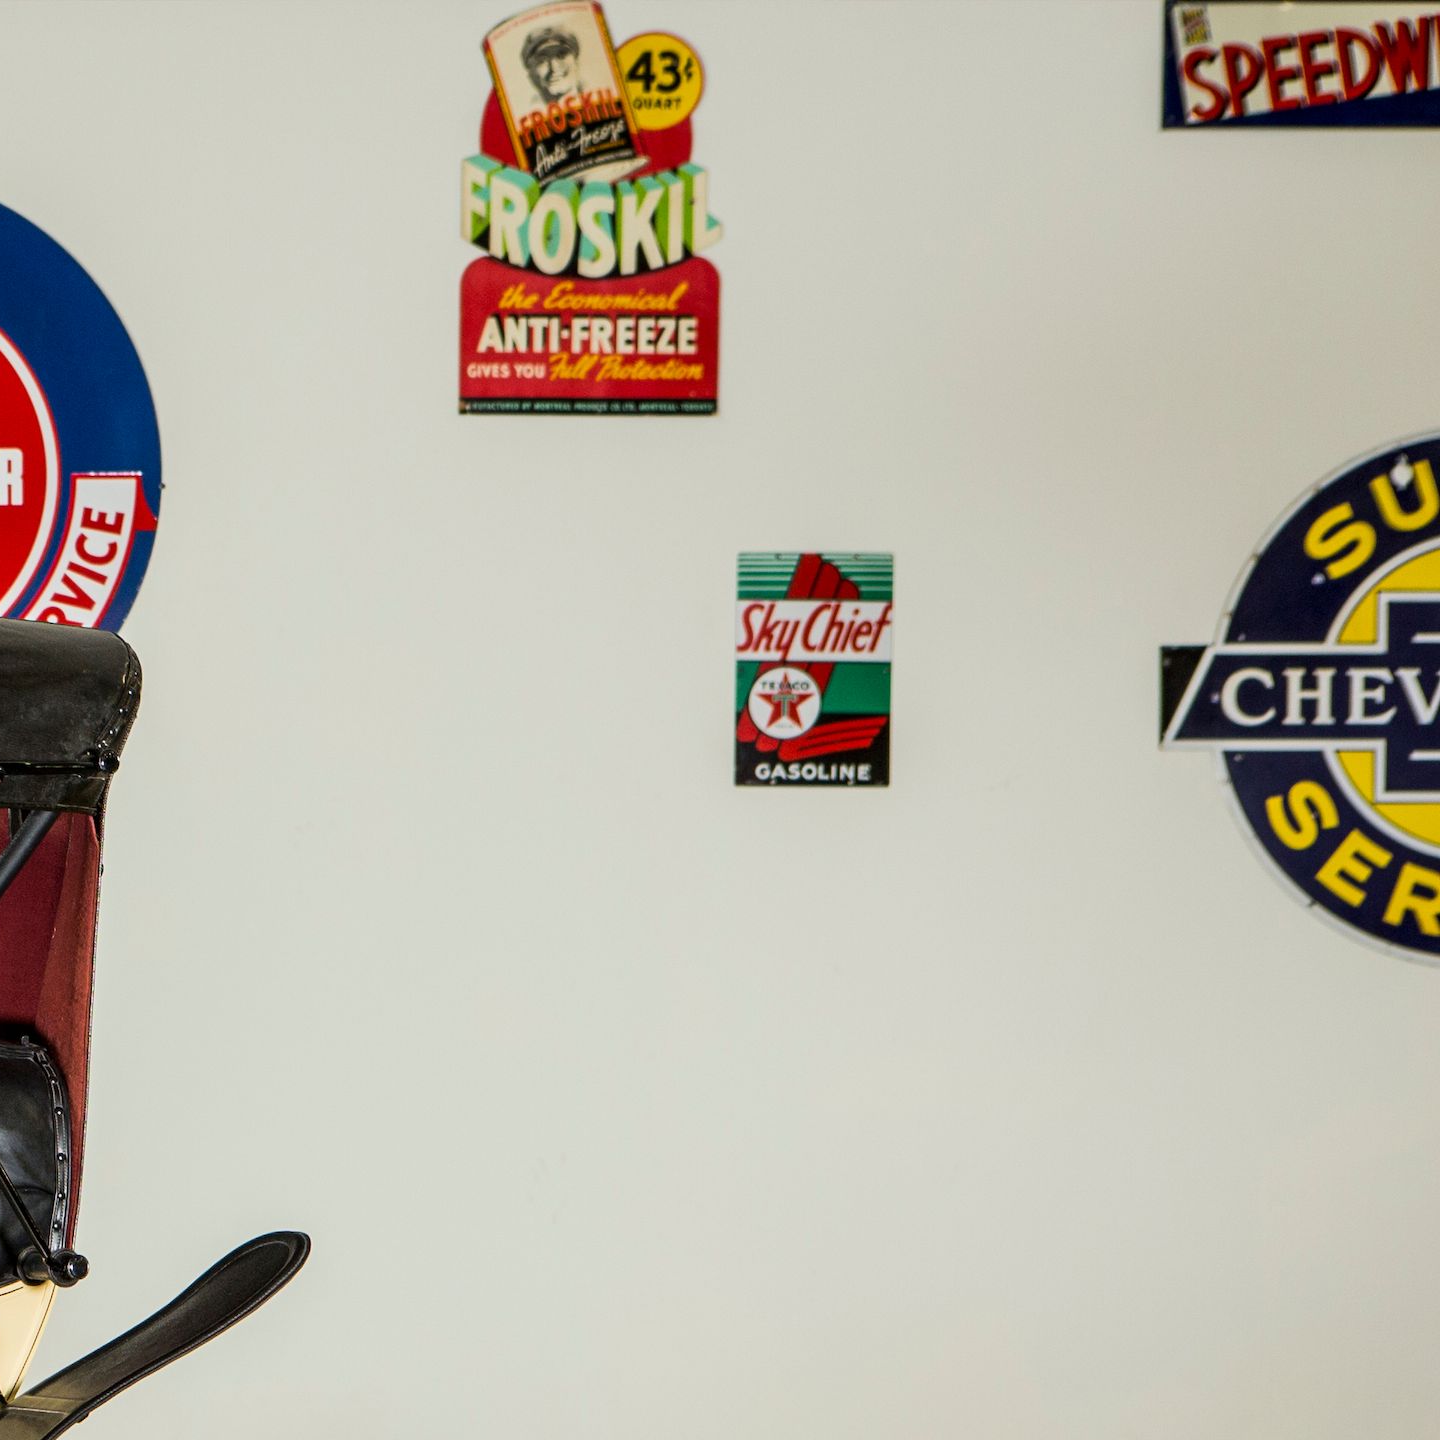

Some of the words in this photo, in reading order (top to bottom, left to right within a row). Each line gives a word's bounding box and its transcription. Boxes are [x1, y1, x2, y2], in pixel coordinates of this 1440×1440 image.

[1183, 14, 1440, 121] SPEEDW
[633, 97, 681, 110] QUART
[460, 158, 723, 279] FROSKIL
[499, 285, 538, 311] the
[544, 281, 688, 311] Economical
[477, 314, 698, 355] ANTI-FREEZE
[467, 363, 510, 379] GIVES
[515, 363, 546, 379] YOU
[595, 355, 704, 382] Protection
[737, 602, 800, 662] Sky
[801, 602, 892, 653] Chief
[755, 762, 871, 783] GASOLINE
